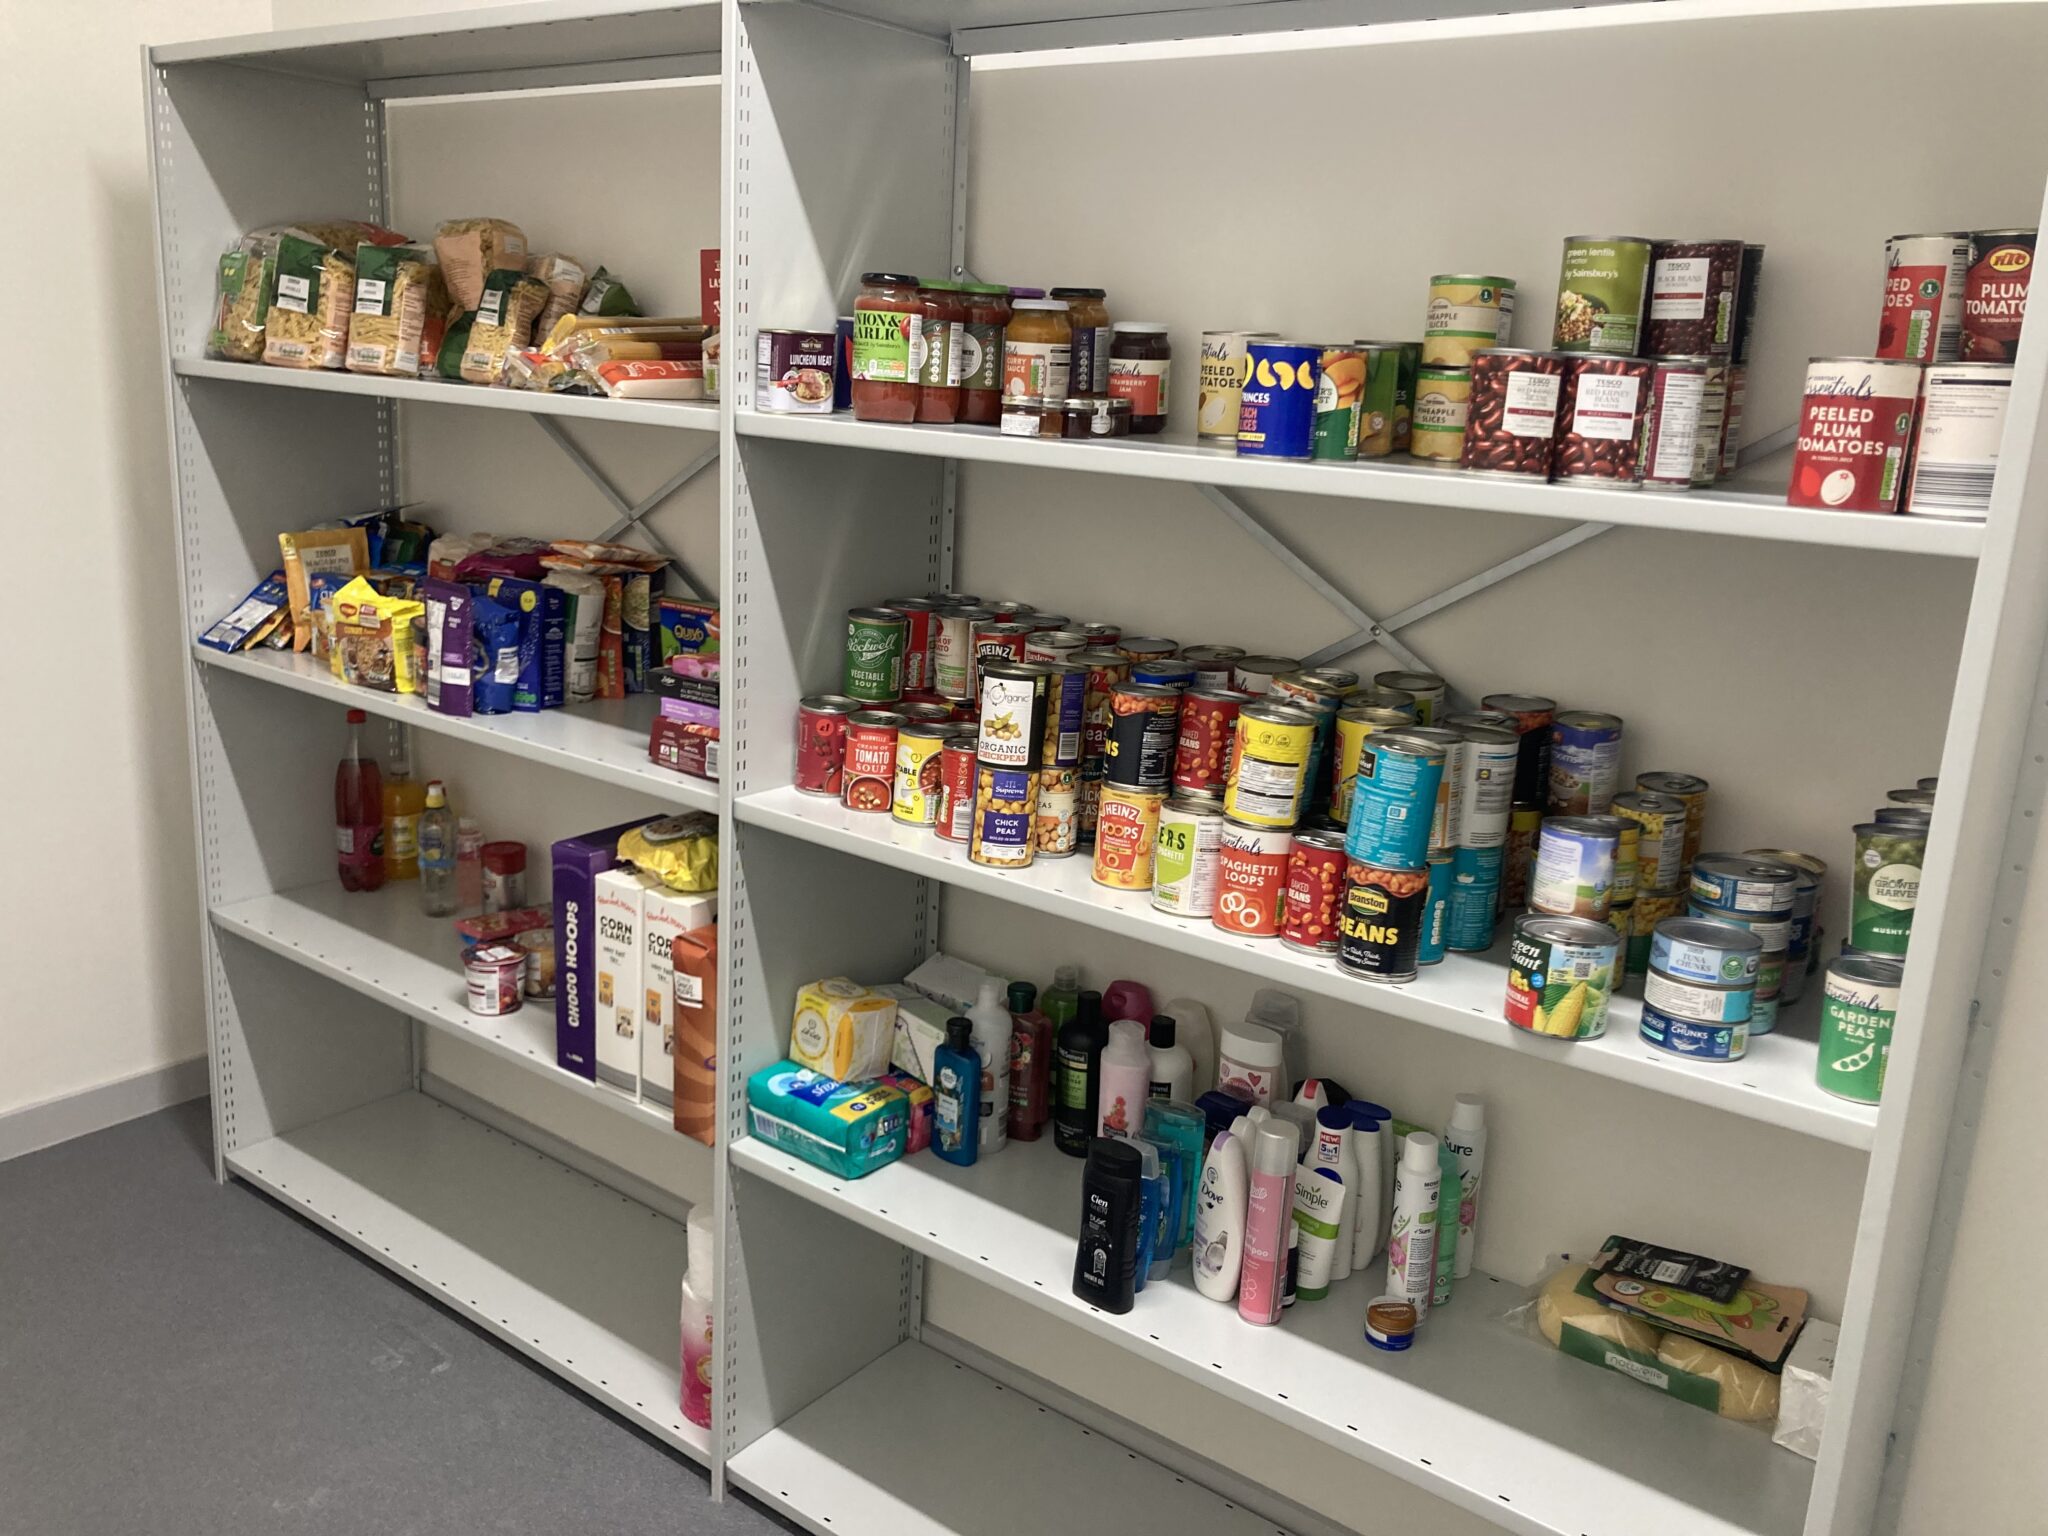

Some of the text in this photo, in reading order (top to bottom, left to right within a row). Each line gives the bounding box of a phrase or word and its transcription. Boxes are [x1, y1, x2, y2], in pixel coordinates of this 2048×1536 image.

[1567, 248, 1615, 259] green lentils
[1667, 262, 1691, 271] TESCO
[1572, 269, 1618, 279] Sainsbury's
[1981, 283, 2030, 299] PLUM
[856, 312, 887, 327] NION
[854, 325, 900, 342] ARLIC
[789, 354, 833, 367] LUNCHEON MEAT
[1007, 357, 1027, 366] CURRY
[1007, 365, 1026, 373] SAUCE
[1201, 364, 1235, 377] PEELED
[1200, 376, 1243, 389] OTATOES
[1596, 379, 1623, 388] TESCO
[1806, 374, 1876, 400] ssentials
[1810, 406, 1874, 423] PEELED
[1813, 422, 1862, 439] PLUM
[1798, 437, 1884, 456] TOMATOES
[980, 644, 1011, 658] HEINZ
[850, 669, 885, 681] VEGETABLE
[979, 741, 1026, 755] ORGANIC
[1179, 736, 1200, 750] BEANS
[855, 748, 890, 765] TOMATO
[978, 751, 1027, 763] CHICKPEAS
[855, 763, 887, 773] SOUP
[995, 785, 1025, 796] Supreme
[1105, 804, 1139, 821] HEINZ
[994, 819, 1019, 827] CHICK
[1101, 820, 1139, 840] HOOPS
[995, 827, 1016, 835] PEAS
[1220, 855, 1279, 876] SPAGHETTI
[1225, 870, 1265, 887] LOOPS
[1288, 888, 1311, 904] BEANS
[1350, 892, 1385, 910] Branston
[600, 916, 633, 935] CORN
[1340, 914, 1399, 945] BEANS
[1872, 927, 1904, 936] MUSHY
[600, 927, 633, 945] FLAKES
[648, 932, 673, 951] COR
[648, 944, 673, 961] FLAK
[1683, 953, 1706, 964] TUNA
[566, 901, 580, 1028] CHOCO HOOPS
[1676, 959, 1712, 972] CHUNKS
[1671, 1020, 1687, 1028] TUNA
[1830, 1005, 1891, 1029] GARDEN
[1670, 1025, 1709, 1039] CHUNKS
[1837, 1021, 1875, 1040] PEAS
[1201, 1183, 1224, 1204] Dove
[1295, 1182, 1328, 1209] Simple
[1090, 1194, 1109, 1208] Cien
